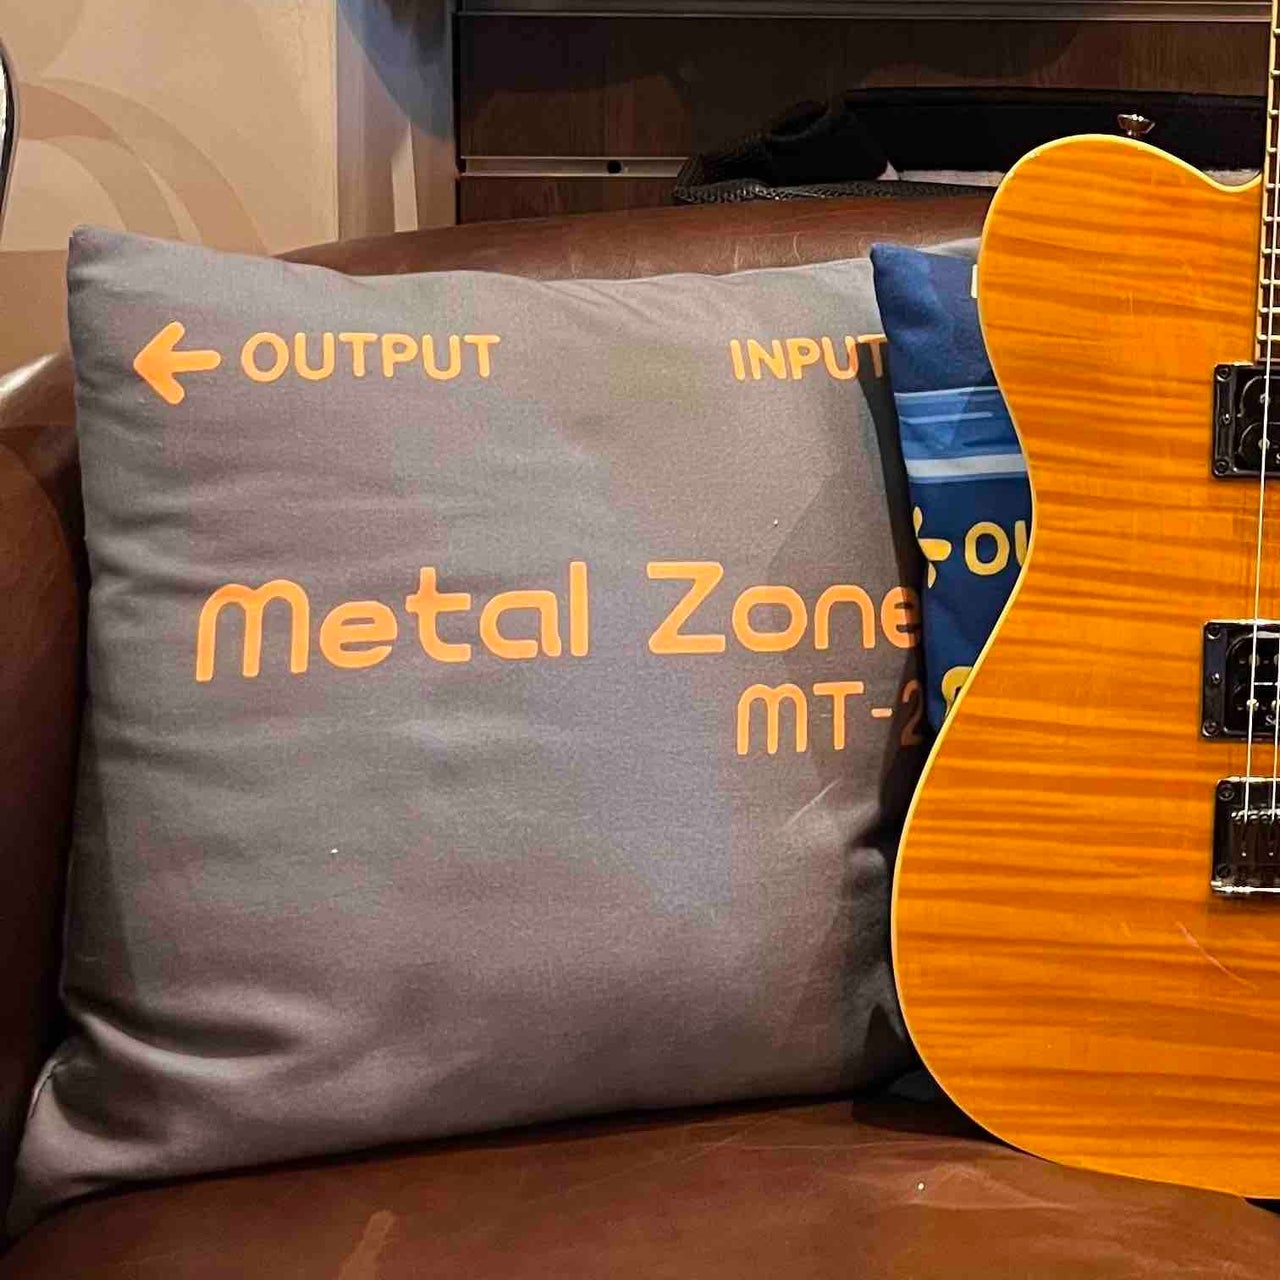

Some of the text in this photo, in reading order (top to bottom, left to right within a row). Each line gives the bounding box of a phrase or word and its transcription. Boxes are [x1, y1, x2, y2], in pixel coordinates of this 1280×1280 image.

[240, 331, 502, 383] OUTPUT
[729, 333, 888, 380] INPUT
[194, 560, 921, 683] Metal Zone
